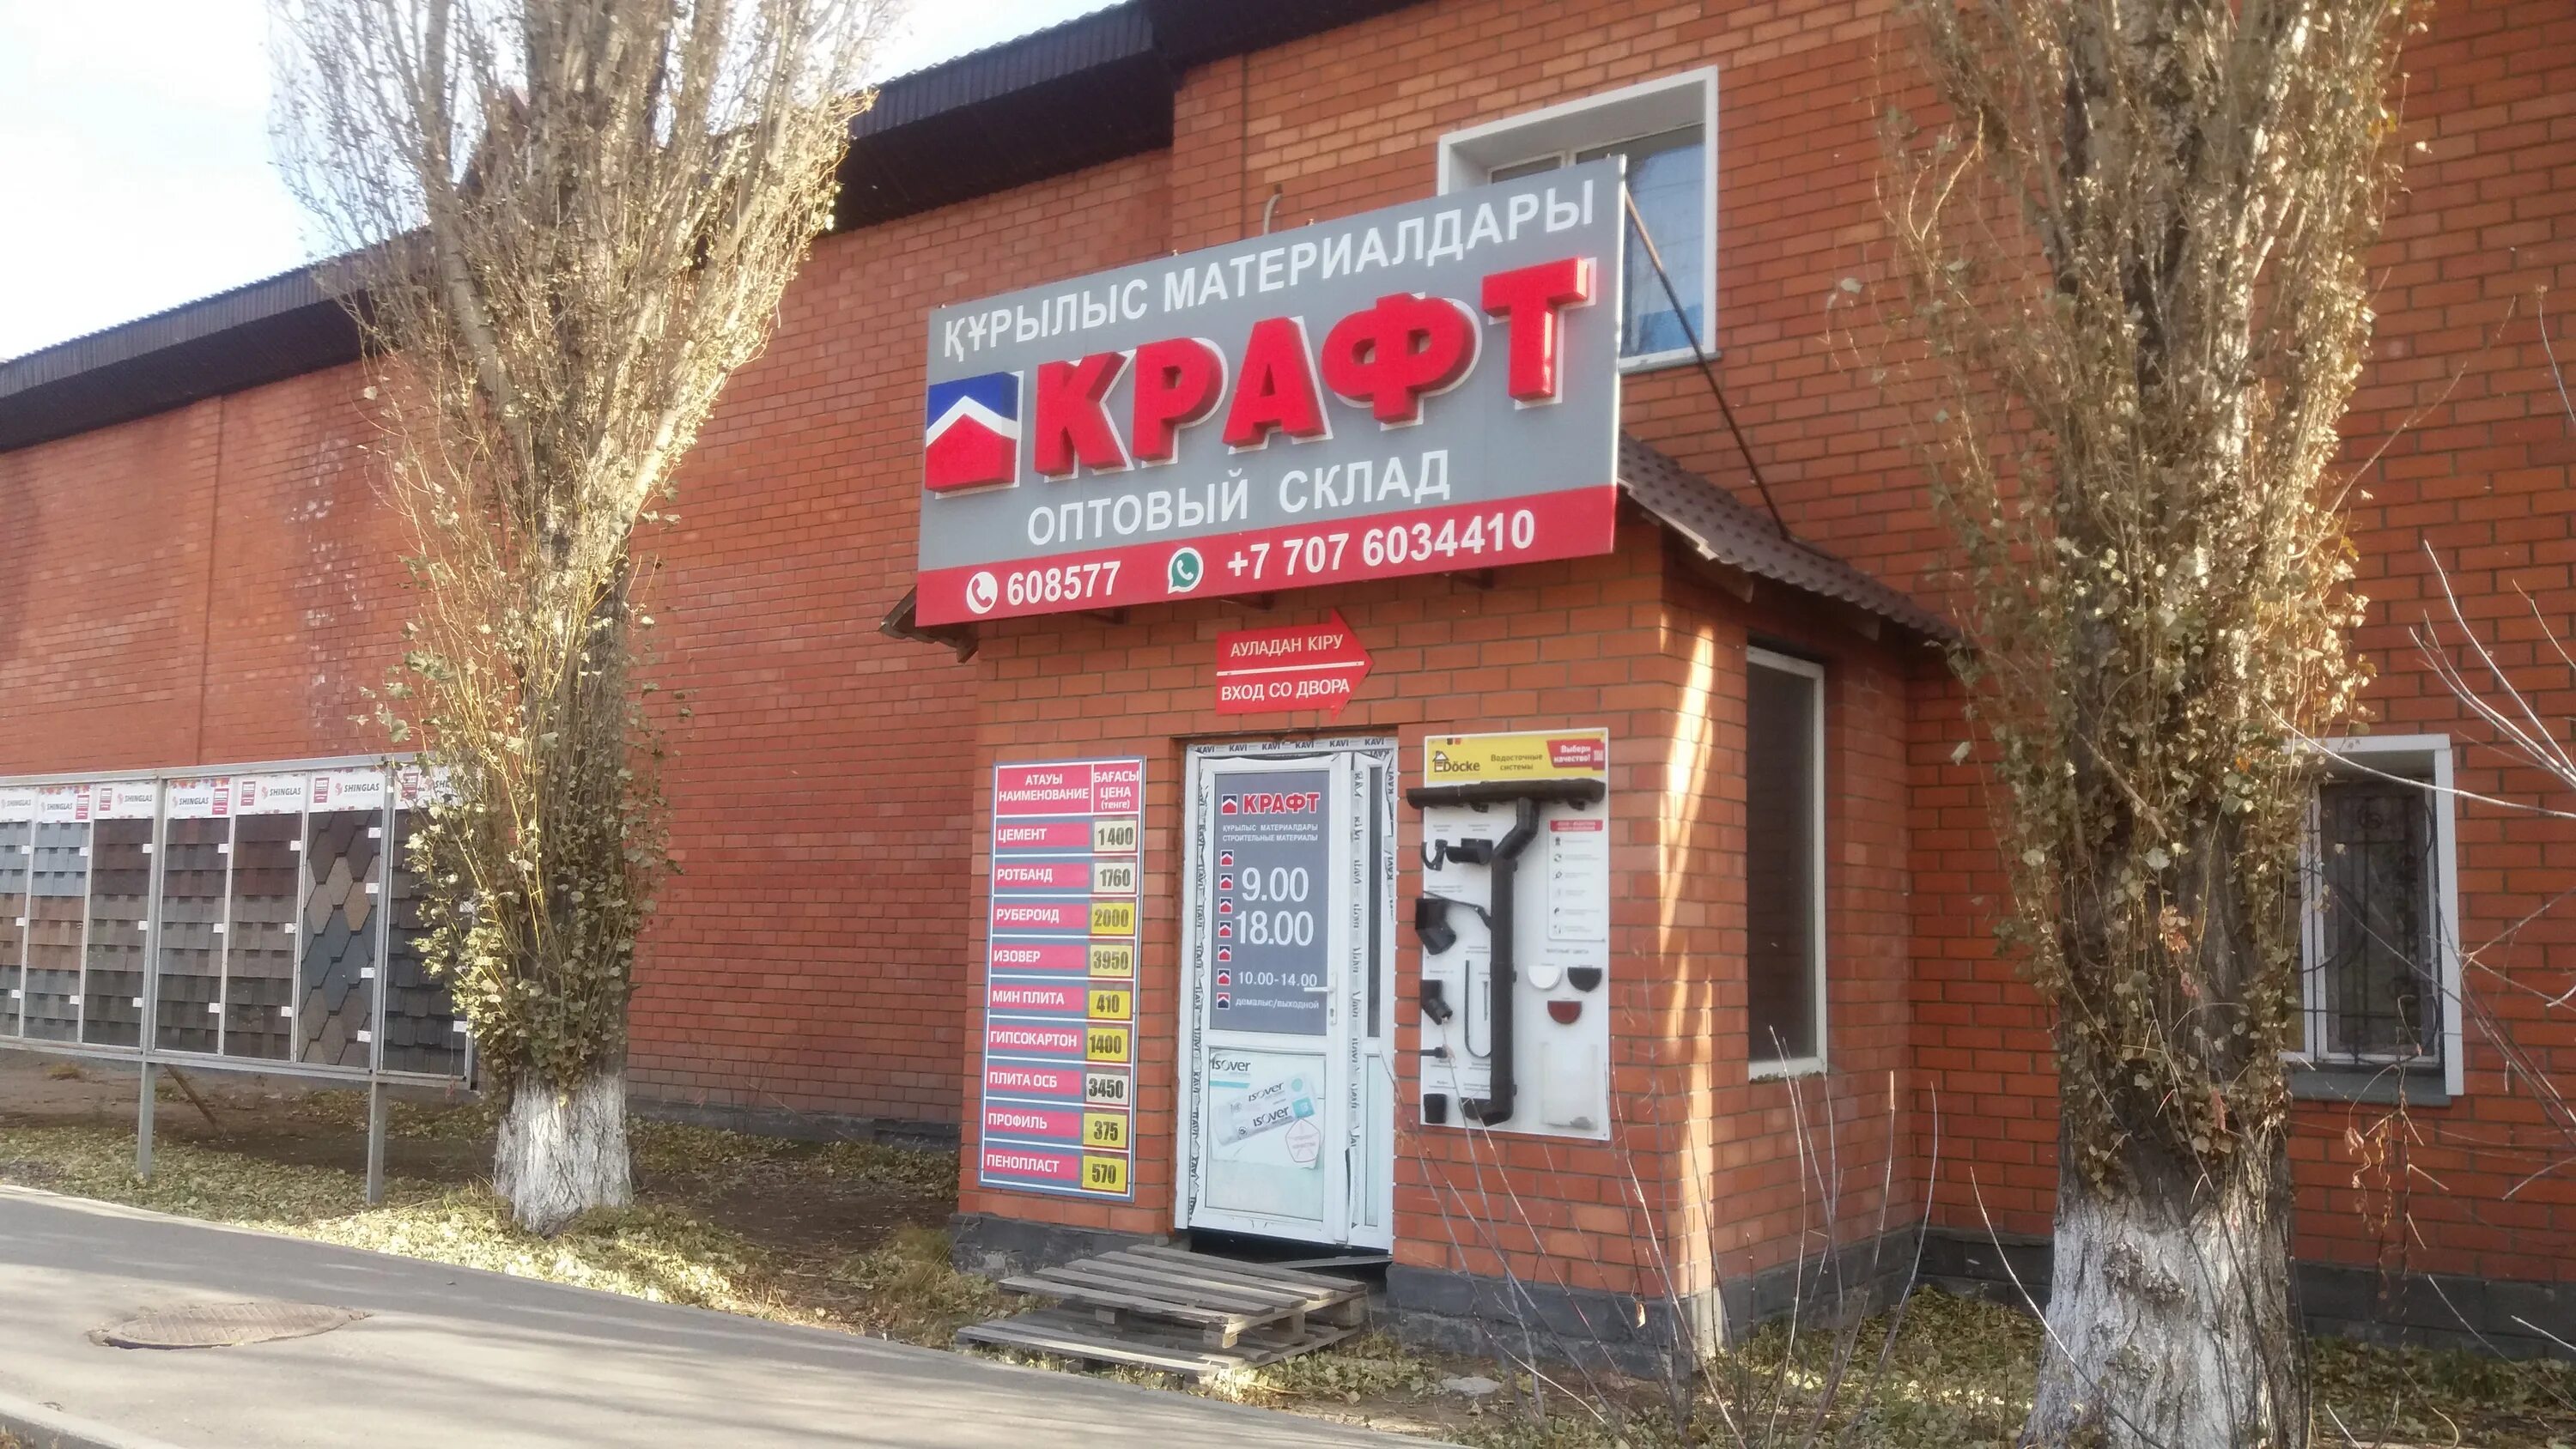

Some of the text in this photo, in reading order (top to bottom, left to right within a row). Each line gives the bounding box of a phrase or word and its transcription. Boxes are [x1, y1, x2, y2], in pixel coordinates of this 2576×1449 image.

[945, 179, 1595, 362] ҚҰРЫЛЫС МАТЕРИАЛДАРЫ
[1034, 256, 1596, 482] КРАФТ
[1027, 450, 1451, 546] ОПТОВЫЙ СКЛАД
[1227, 509, 1535, 580] +7 707 6034410
[1007, 561, 1121, 606] 608577
[1230, 634, 1344, 658] АУЛАДАН КІРУ
[1221, 678, 1351, 702] ВХОД СО ДВОРА
[1229, 743, 1248, 752] KAVI
[1261, 742, 1281, 751] KAVI
[1295, 741, 1315, 749] KAVI
[1329, 739, 1350, 748] KAVI
[1364, 737, 1385, 746] KAVI
[1491, 753, 1543, 763] Водосточные
[1499, 763, 1534, 772] системы
[1025, 773, 1063, 785] АТАУЫ
[1093, 770, 1139, 783] БАҒАСЫ
[269, 786, 301, 797] SHINGLAS
[343, 782, 380, 793] SHINGLAS
[999, 788, 1089, 802] НАИМЕНОВАНИЕ
[1100, 786, 1132, 798] ЦЕНА
[124, 793, 153, 803] SHINGLAS
[179, 796, 210, 806] SHINGLAS
[1100, 799, 1130, 810] (тенге)
[1242, 791, 1321, 815] КРАФТ
[46, 802, 73, 811] SHINGLAS
[997, 828, 1048, 843] ЦЕМЕНТ
[1260, 823, 1319, 833] МАТЕРИАЛДАРЫ
[1222, 834, 1319, 843] СТРОИТЕЛЬНЫЕ МАТЕРИАЛЫ
[997, 868, 1131, 888] РОТБАНД 1760
[1242, 867, 1309, 901] 9.00
[996, 908, 1060, 924] РУБЕРОИД
[1235, 910, 1314, 946] 18.00
[993, 949, 1129, 970] ИЗОВЕР 3950
[1238, 971, 1318, 987] 10.00-14.00
[992, 990, 1121, 1013] МИН ПЛИТА 410
[990, 1030, 1122, 1054] ГИПСОКАРТОН 1400
[989, 1071, 1125, 1100] ПЛИТА ОСБ 3450
[987, 1113, 1119, 1142] ПРОФИЛЬ 375
[986, 1154, 1117, 1185] ПЕНОПЛАСТ 570
